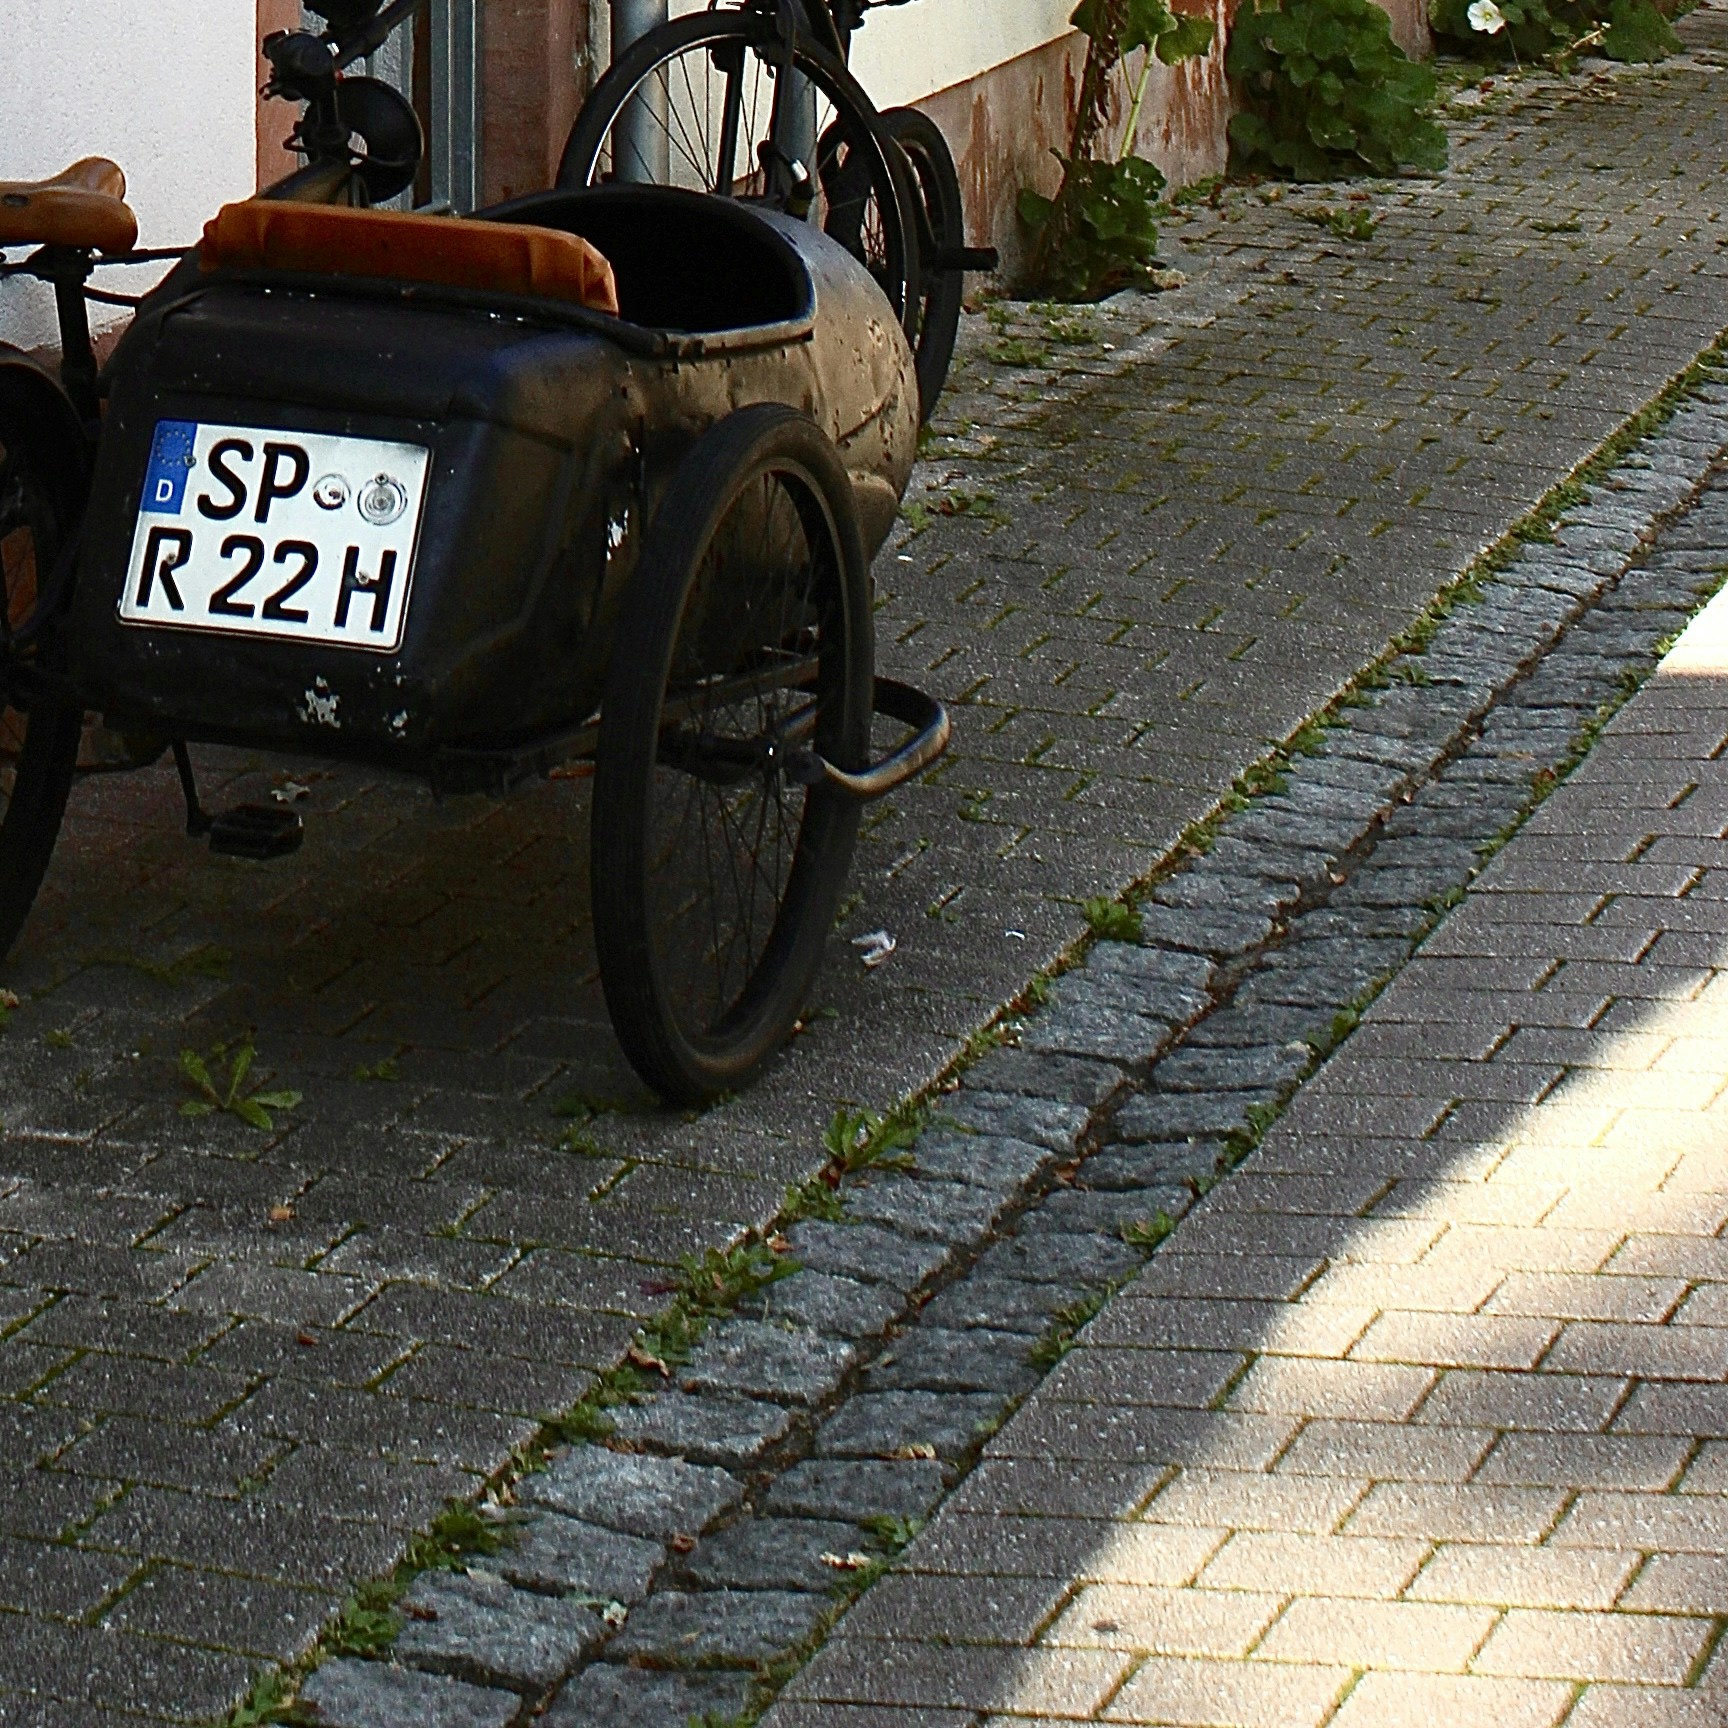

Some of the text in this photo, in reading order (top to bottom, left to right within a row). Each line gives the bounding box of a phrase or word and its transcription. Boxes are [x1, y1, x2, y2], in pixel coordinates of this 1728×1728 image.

[155, 479, 174, 503] D
[197, 438, 310, 524] SP
[136, 526, 194, 611] R
